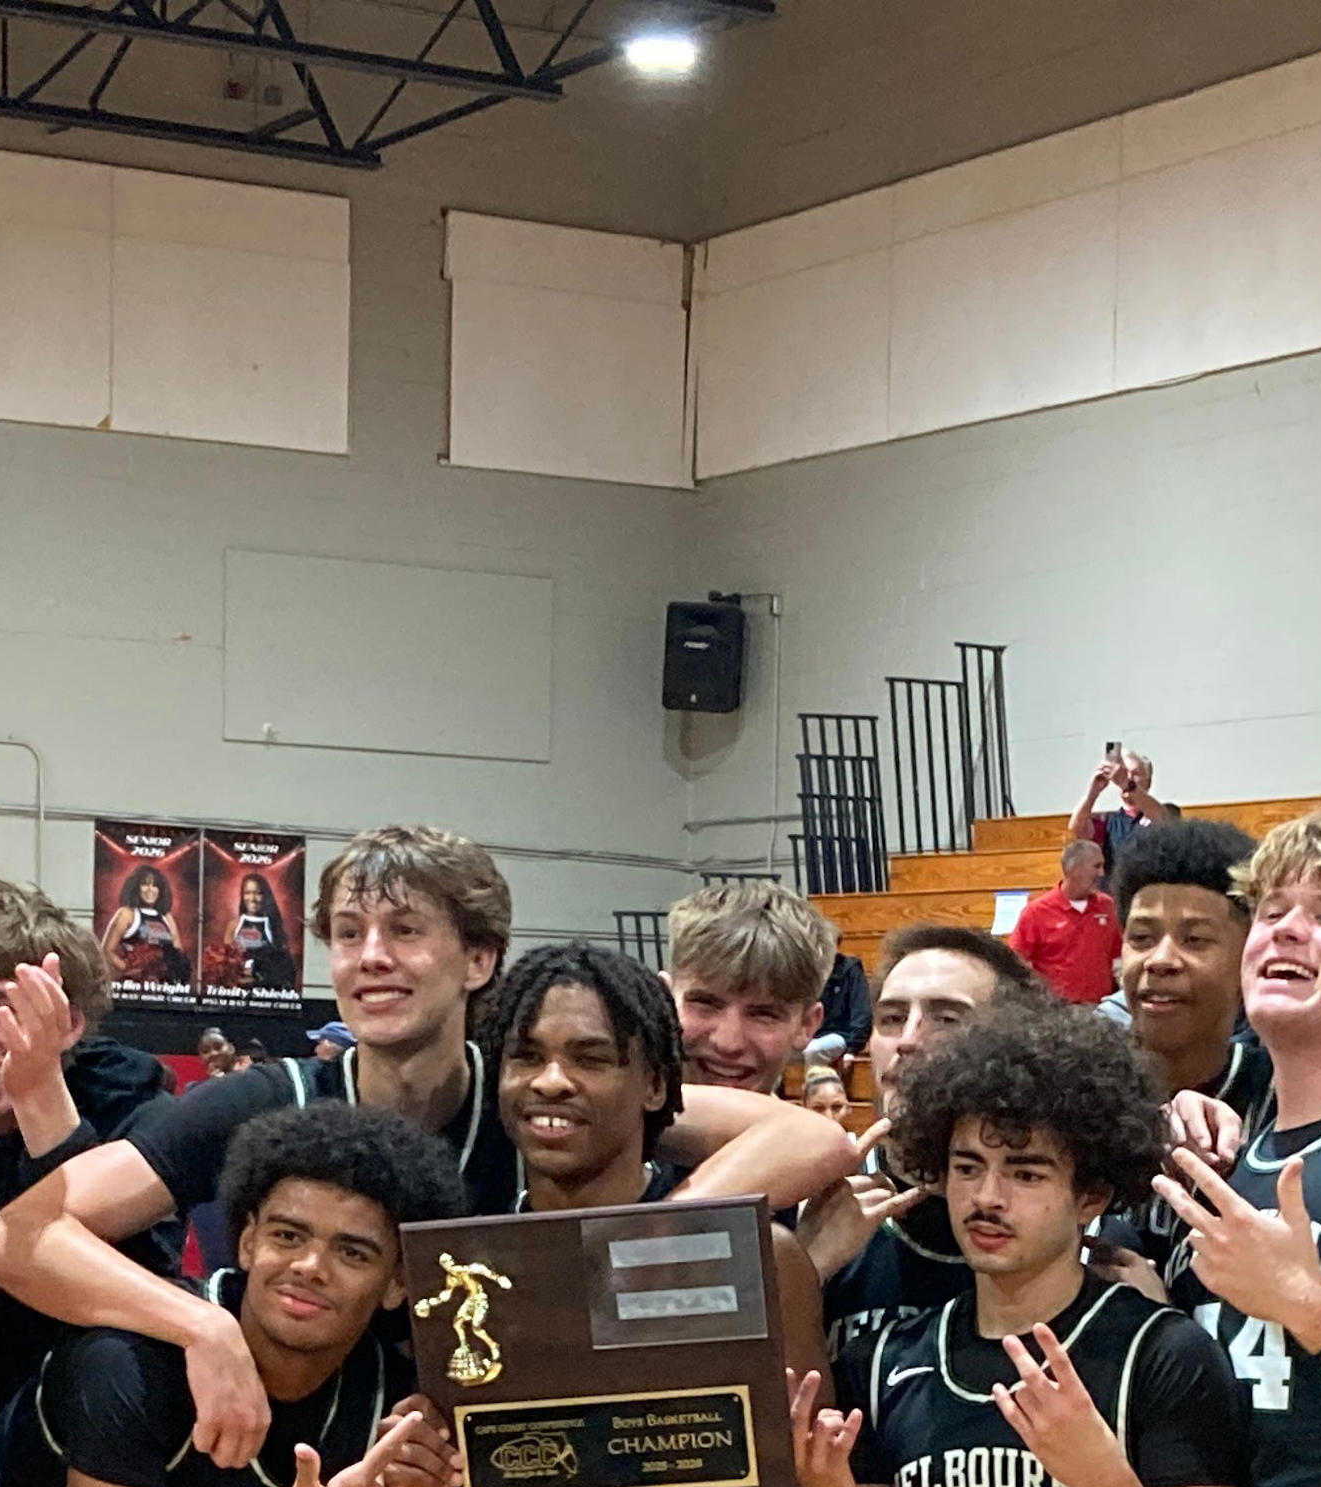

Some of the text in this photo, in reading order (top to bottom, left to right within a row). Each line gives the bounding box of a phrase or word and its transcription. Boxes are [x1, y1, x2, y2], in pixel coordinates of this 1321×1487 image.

[126, 834, 172, 847] SENIOR
[130, 846, 166, 858] 2026
[233, 841, 280, 855] SENIOR
[238, 854, 273, 866] 2026
[143, 981, 191, 994] Wright
[206, 985, 250, 999] Trinity
[251, 987, 300, 1000] Shields
[646, 1411, 723, 1428] BASKETBALL
[607, 1430, 733, 1455] CHAMPION
